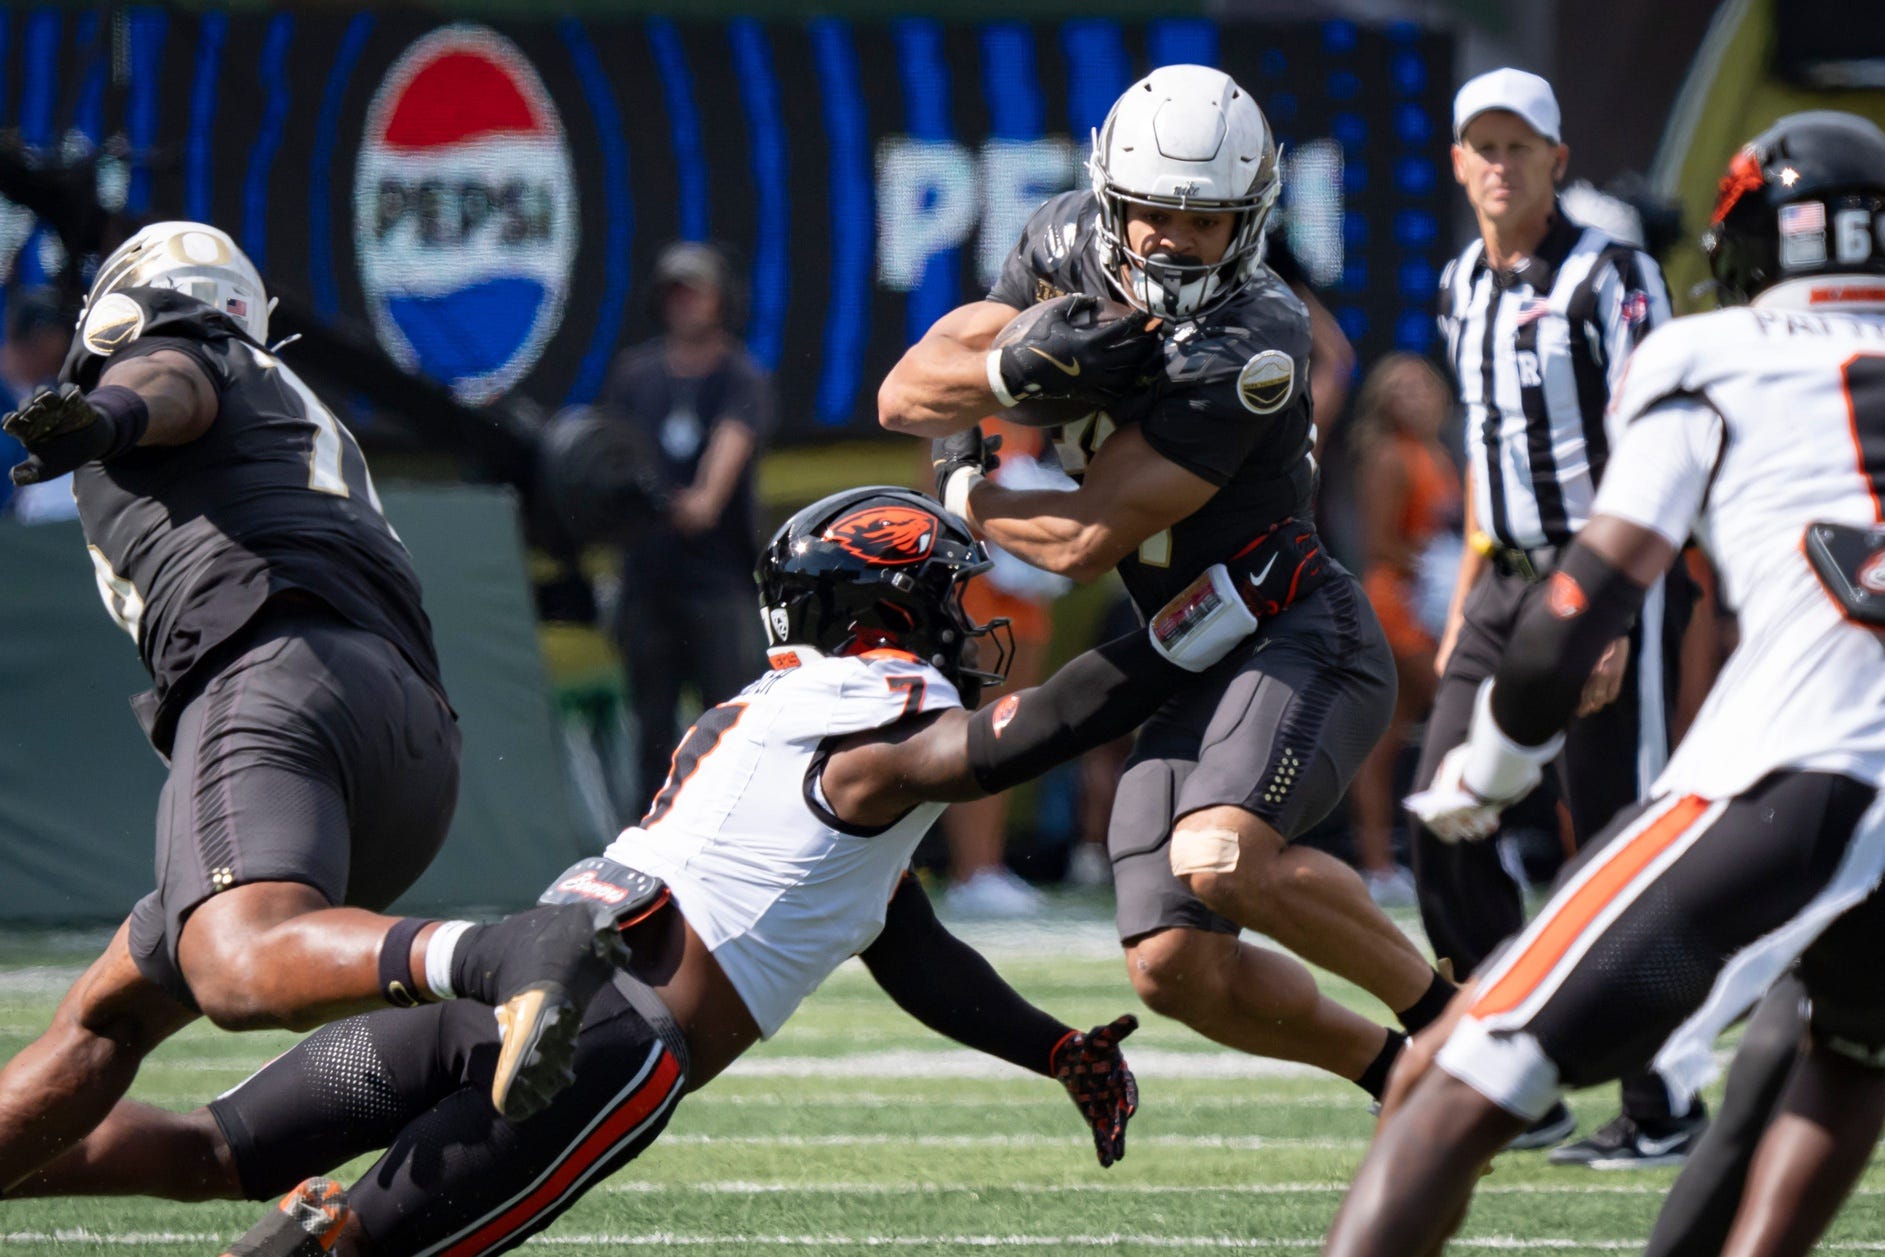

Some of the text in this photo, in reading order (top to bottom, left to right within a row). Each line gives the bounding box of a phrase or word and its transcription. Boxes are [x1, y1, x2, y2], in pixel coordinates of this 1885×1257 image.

[375, 176, 553, 245] PEPSI
[877, 136, 1344, 291] PEI
[1517, 350, 1542, 388] R
[885, 675, 927, 718] 7
